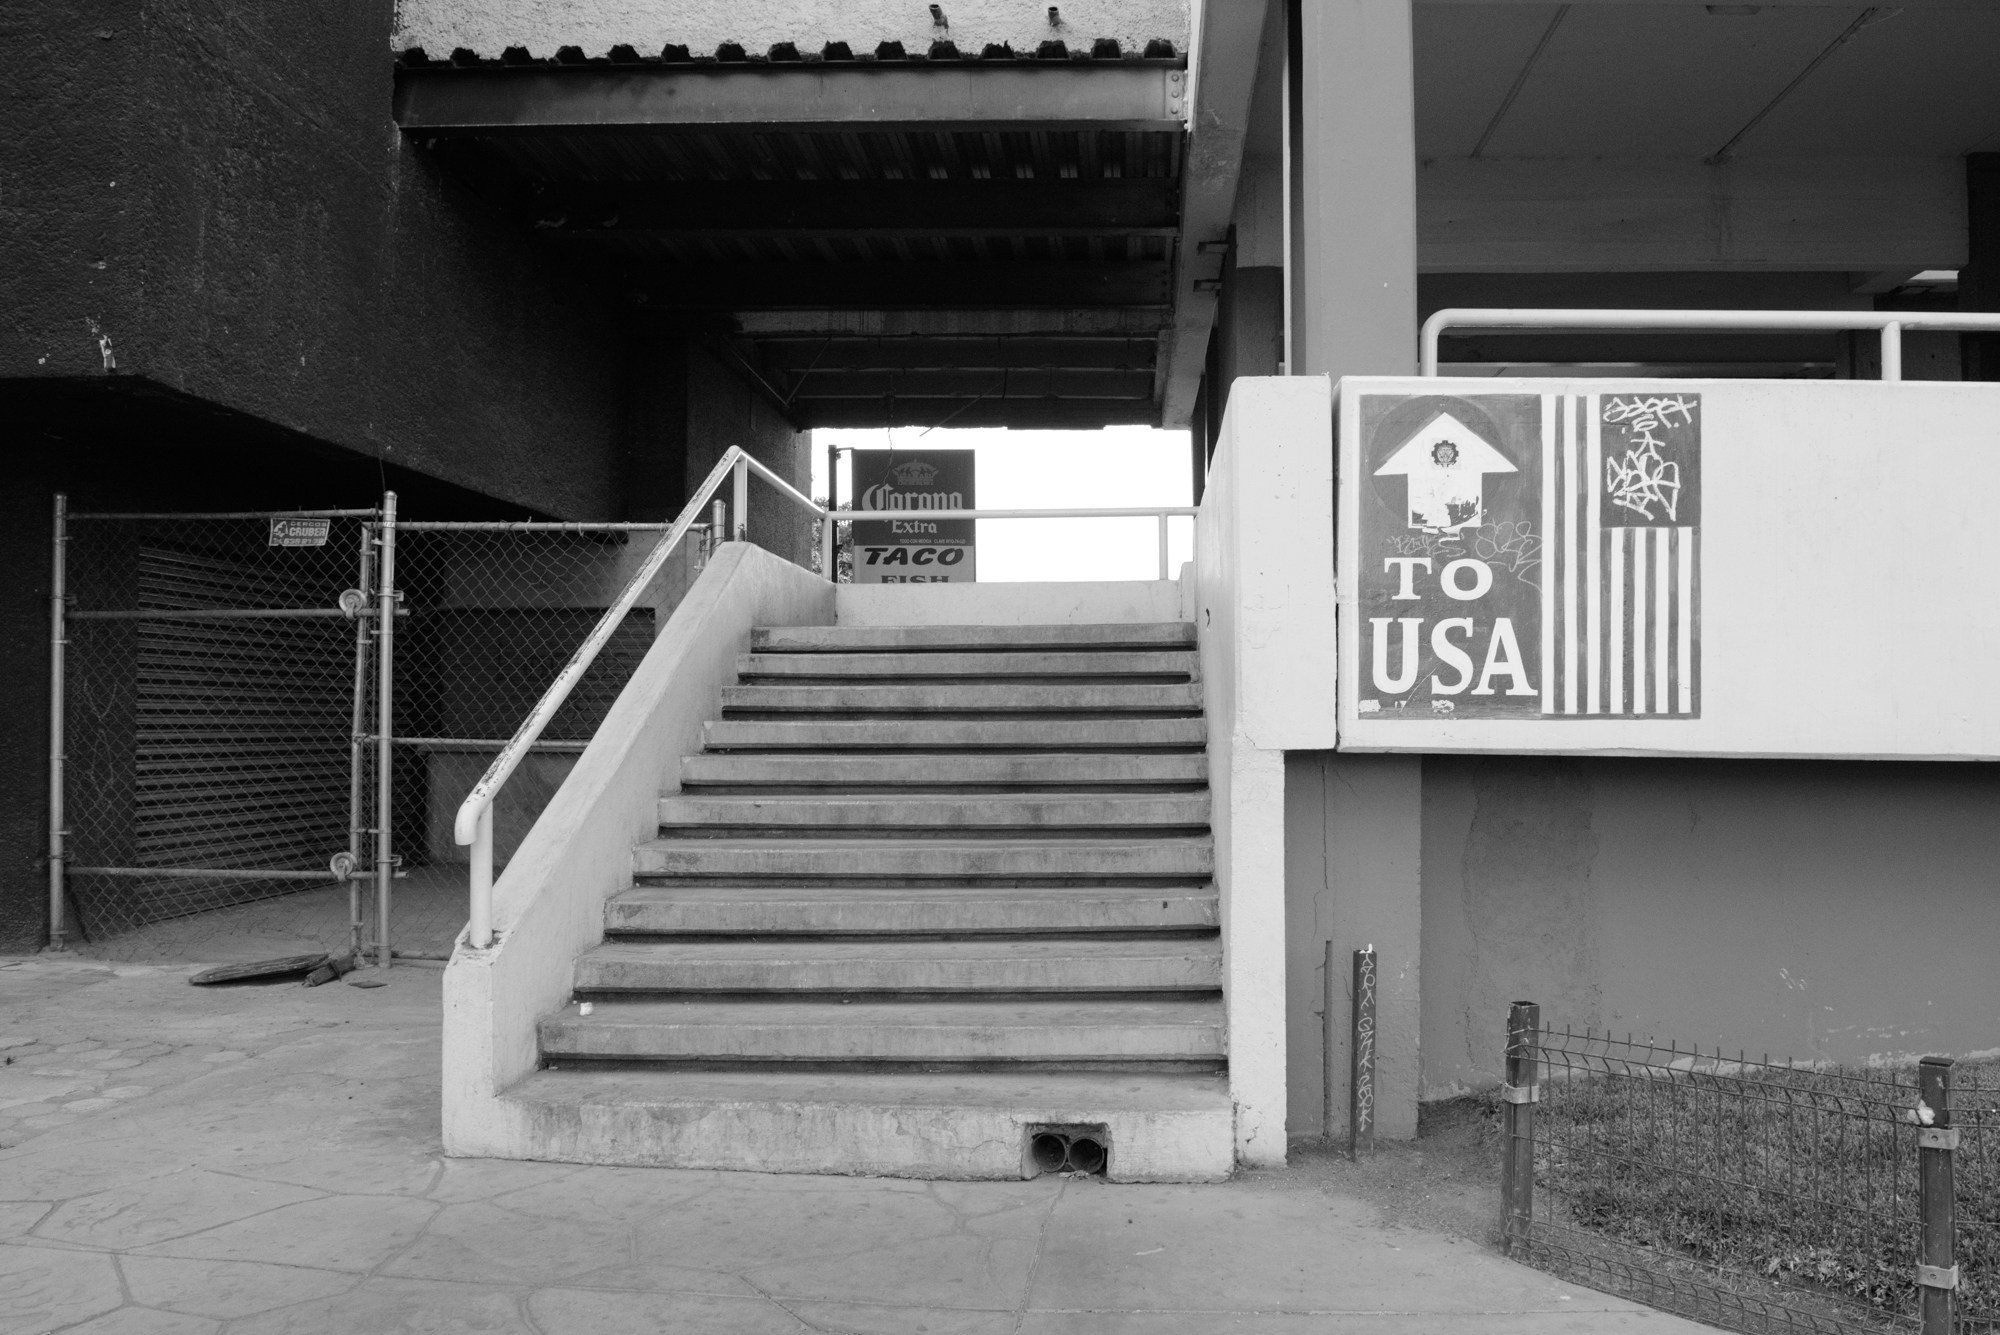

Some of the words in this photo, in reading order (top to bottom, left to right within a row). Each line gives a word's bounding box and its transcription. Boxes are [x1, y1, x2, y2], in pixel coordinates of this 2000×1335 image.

[861, 483, 964, 521] Corona
[892, 519, 938, 534] Extra
[864, 547, 964, 566] TACO
[881, 575, 950, 584] FISH
[1384, 557, 1494, 601] TO
[1369, 617, 1539, 697] USA
